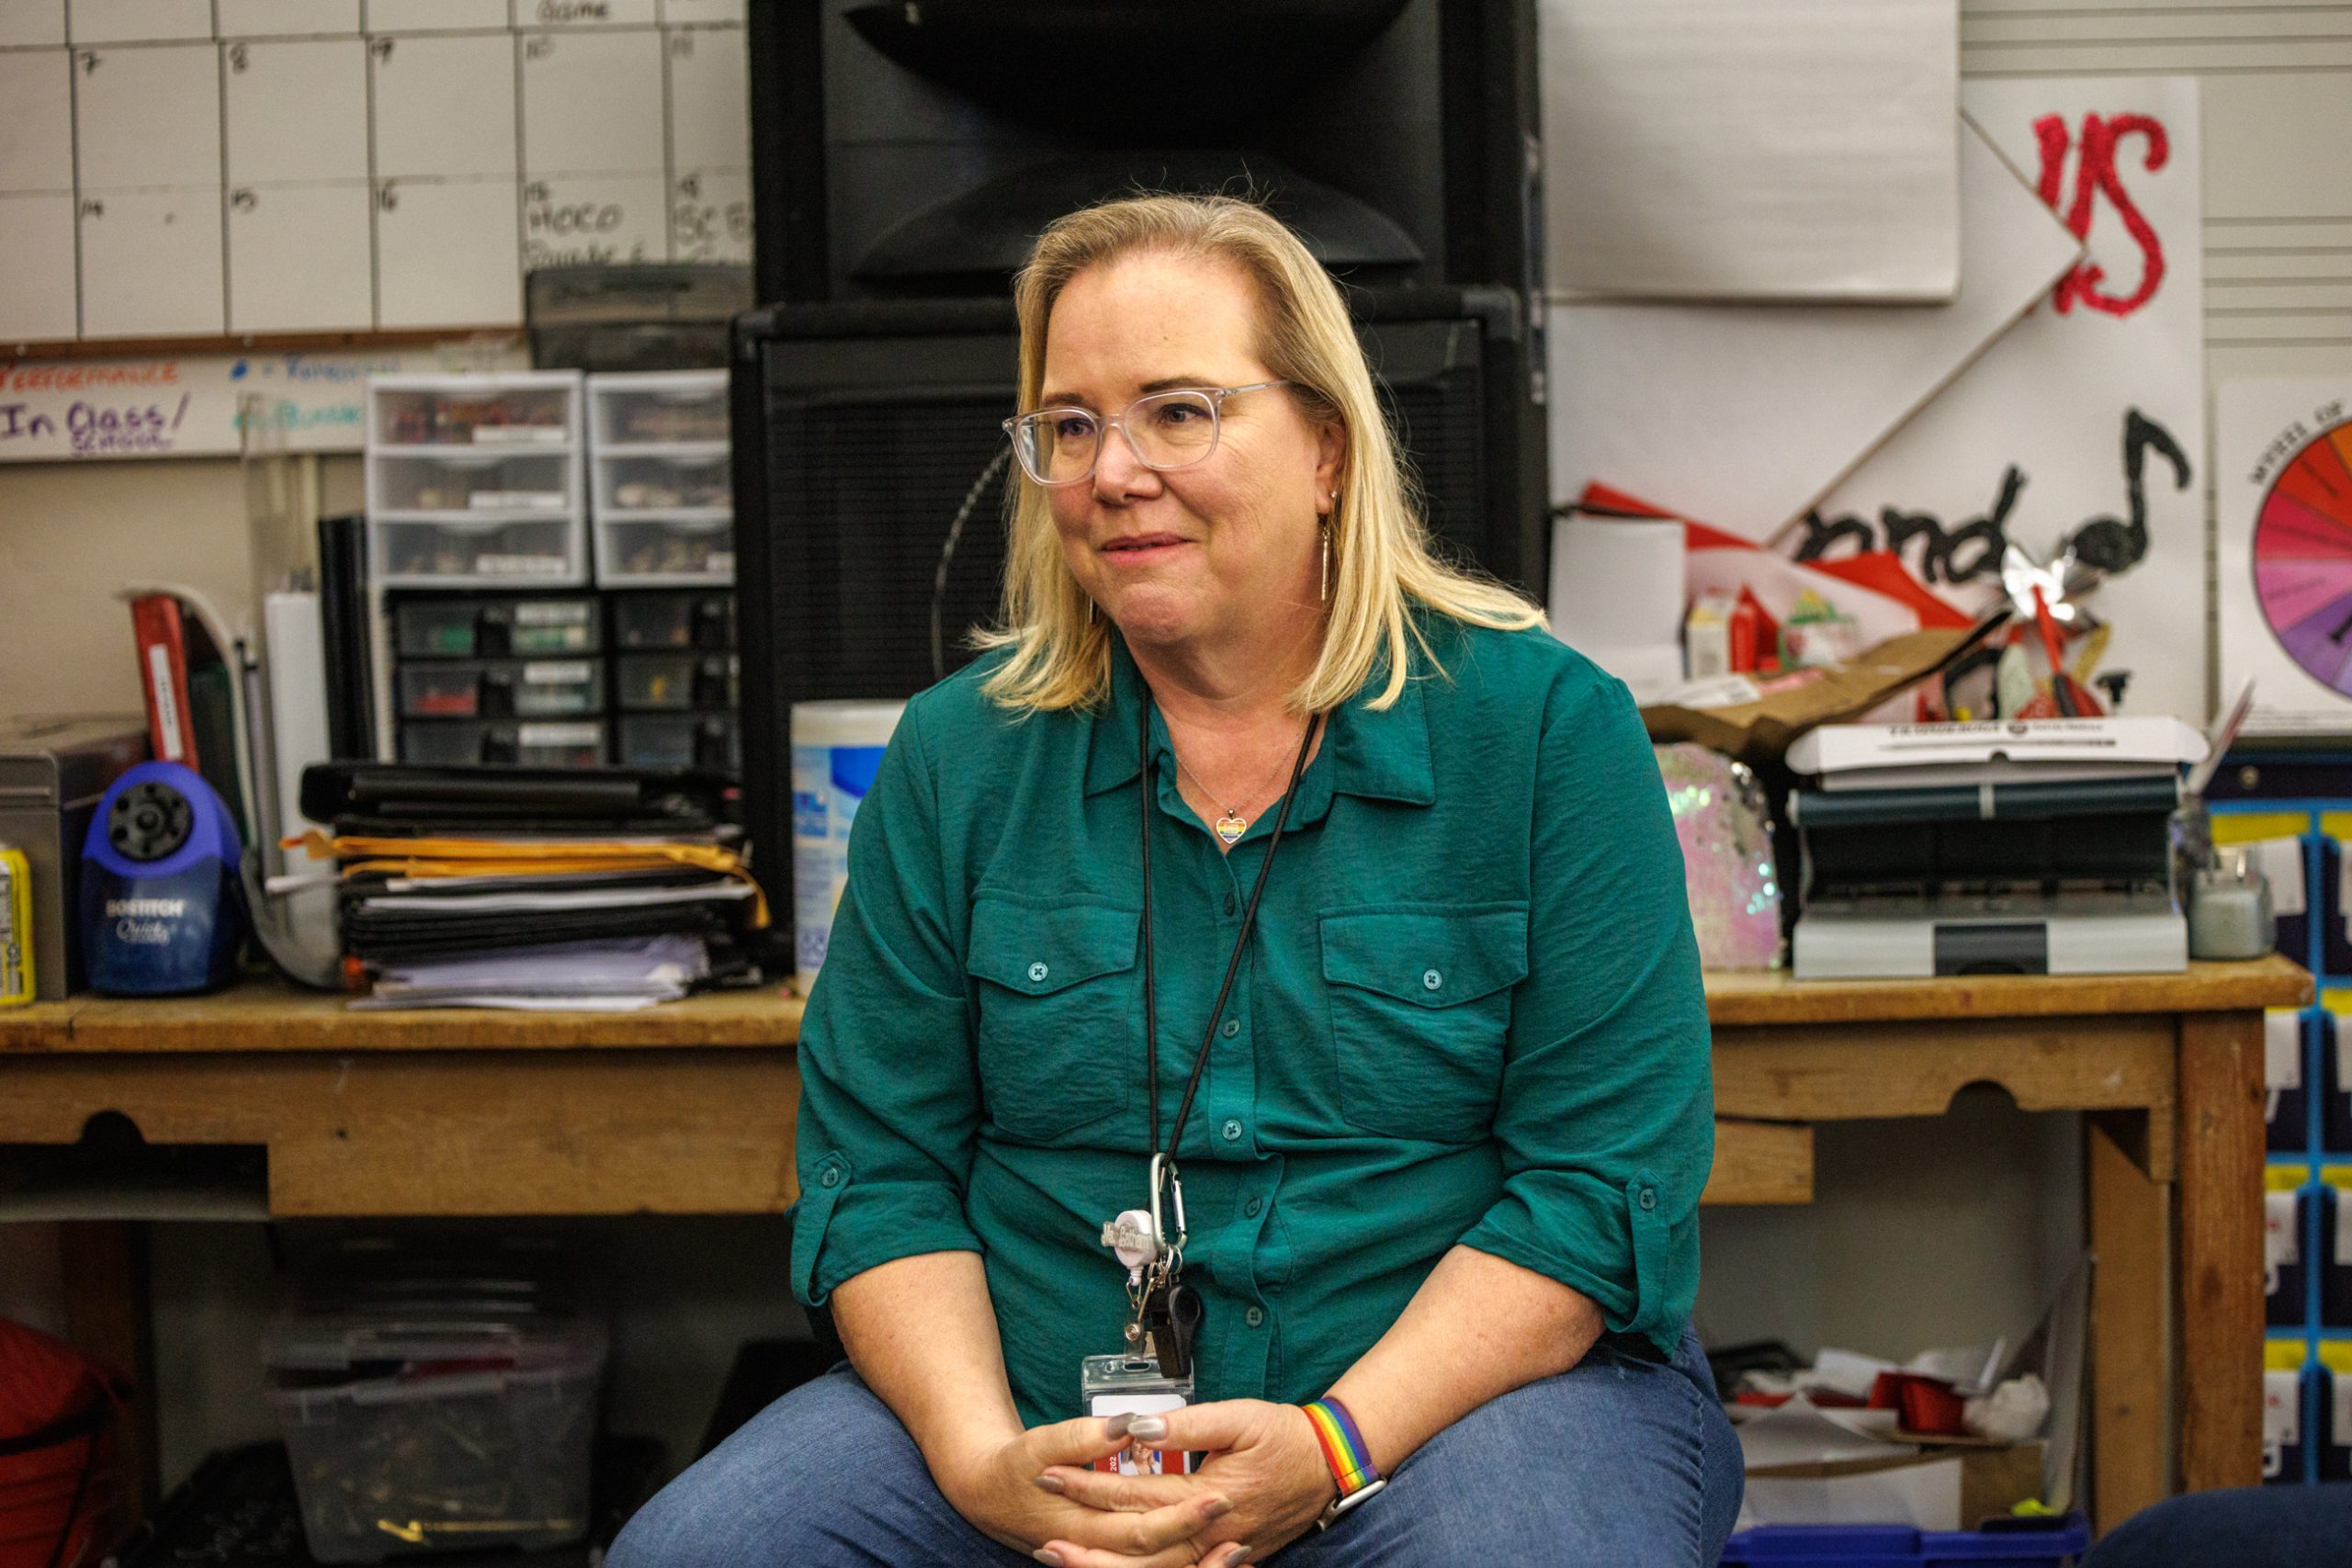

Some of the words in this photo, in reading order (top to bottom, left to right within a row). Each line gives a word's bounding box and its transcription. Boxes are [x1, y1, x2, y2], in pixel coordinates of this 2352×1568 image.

[78, 51, 102, 76] 7
[230, 44, 249, 73] 8
[0, 403, 55, 439] In
